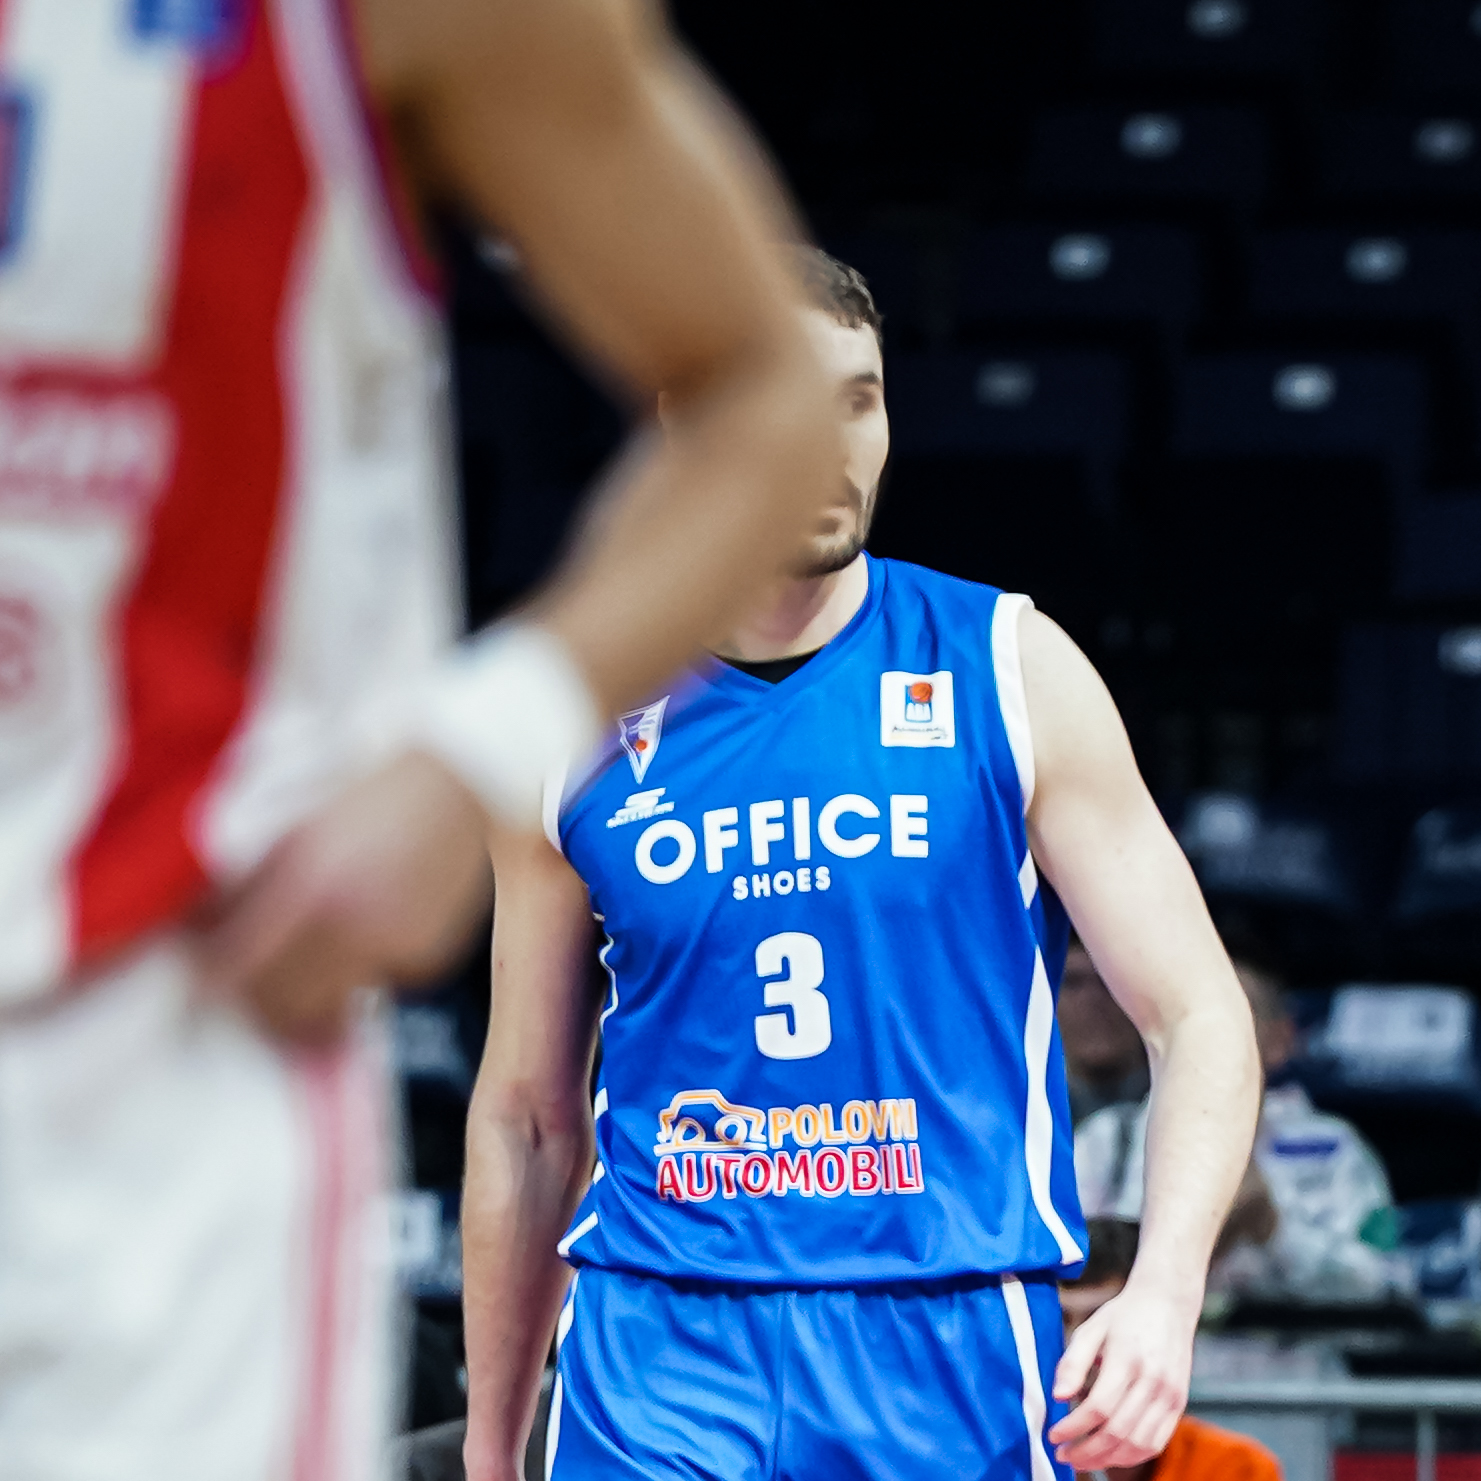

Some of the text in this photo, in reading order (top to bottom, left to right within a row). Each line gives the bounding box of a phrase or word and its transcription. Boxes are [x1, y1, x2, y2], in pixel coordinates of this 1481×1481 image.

[635, 793, 929, 885] OFFICE
[732, 865, 831, 901] SHOES
[755, 932, 832, 1060] 3
[656, 1142, 925, 1203] AUTOMOBILI
